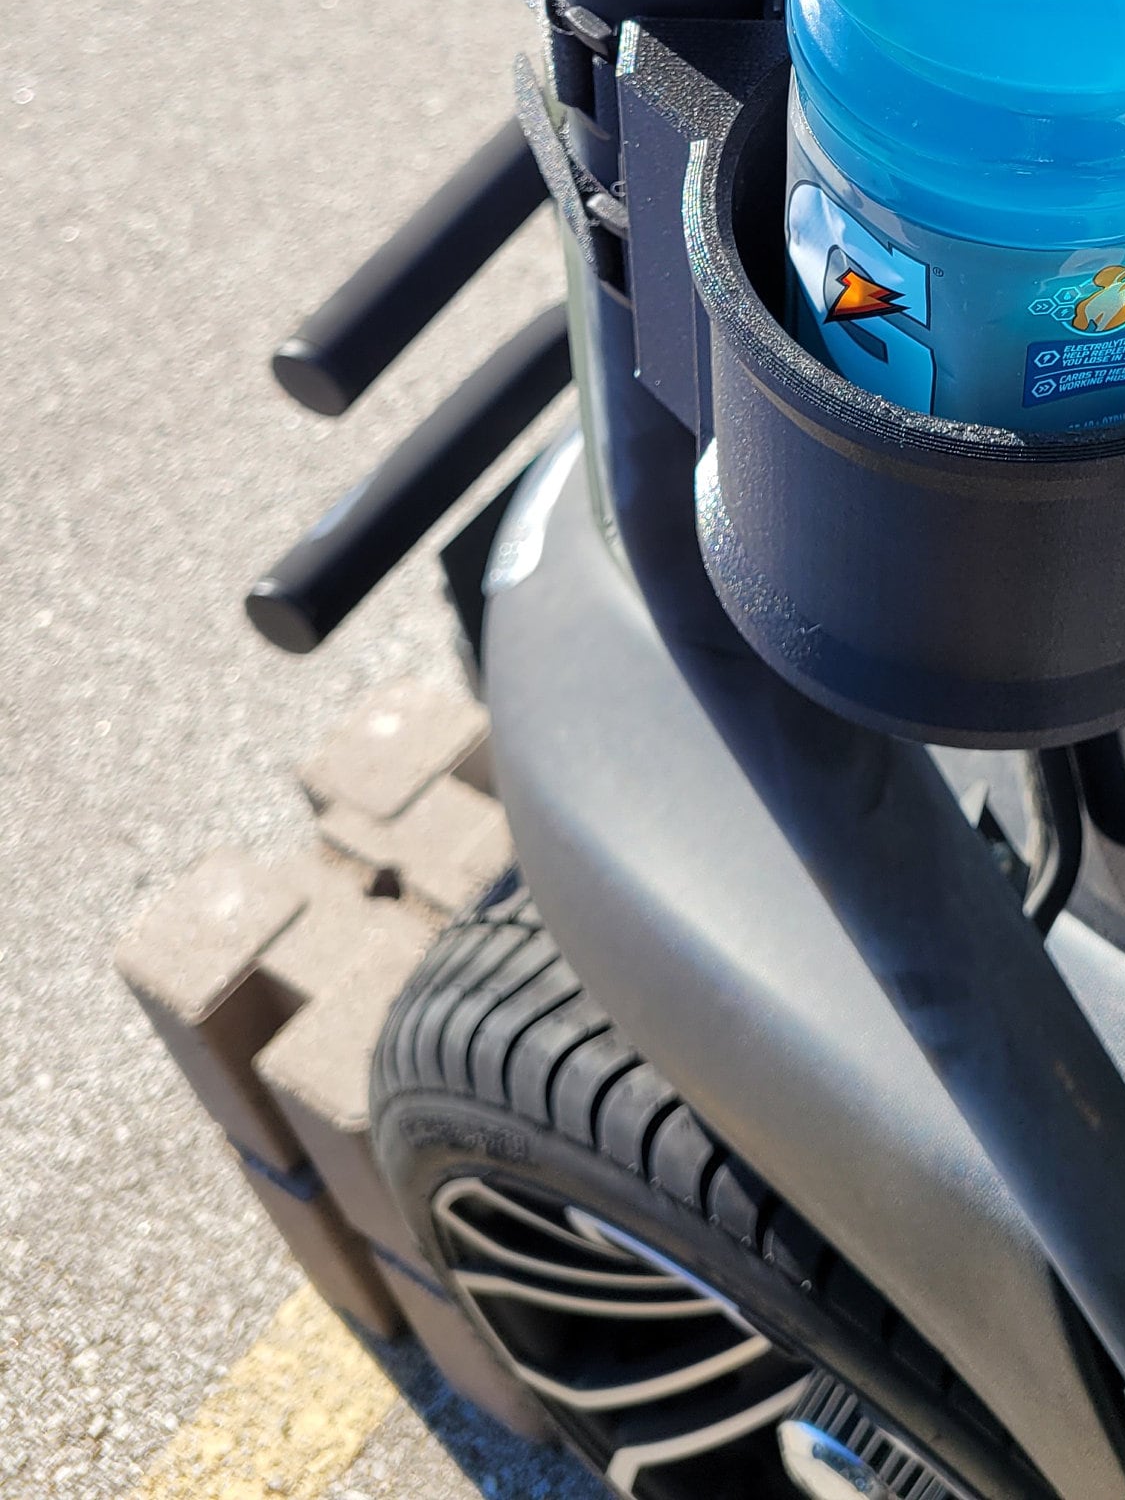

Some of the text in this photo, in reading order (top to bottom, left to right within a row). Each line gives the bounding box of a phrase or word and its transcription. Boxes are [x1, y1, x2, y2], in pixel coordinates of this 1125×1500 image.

[1062, 357, 1082, 367] YOU
[1083, 355, 1110, 364] LOSE
[1111, 352, 1121, 361] IN
[1063, 349, 1089, 359] HELP
[1059, 371, 1093, 384] CARBS
[1094, 369, 1107, 378] TO
[1059, 376, 1104, 392] WORKING
